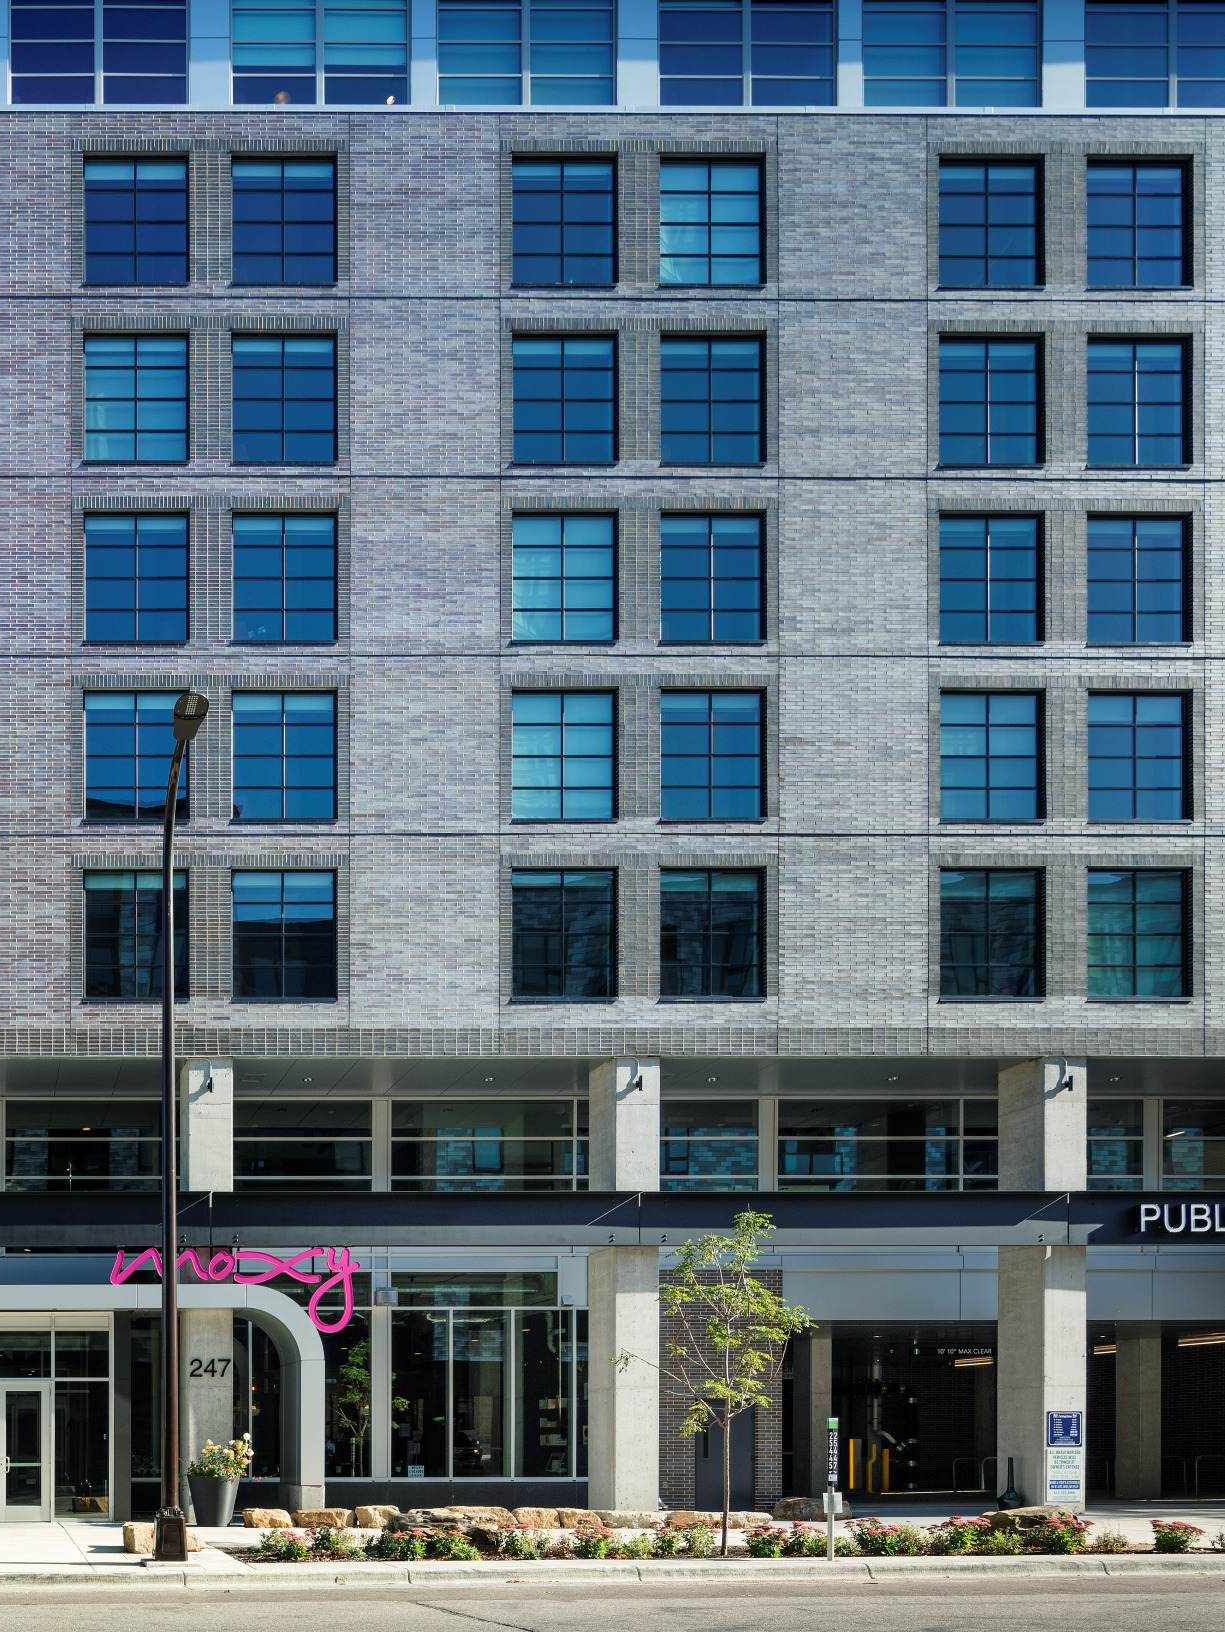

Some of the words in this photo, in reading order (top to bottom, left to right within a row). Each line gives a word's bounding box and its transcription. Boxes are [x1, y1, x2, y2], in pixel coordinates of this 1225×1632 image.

[1140, 1203, 1225, 1233] PUBL
[110, 1247, 361, 1334] moxy
[189, 1358, 232, 1378] 247
